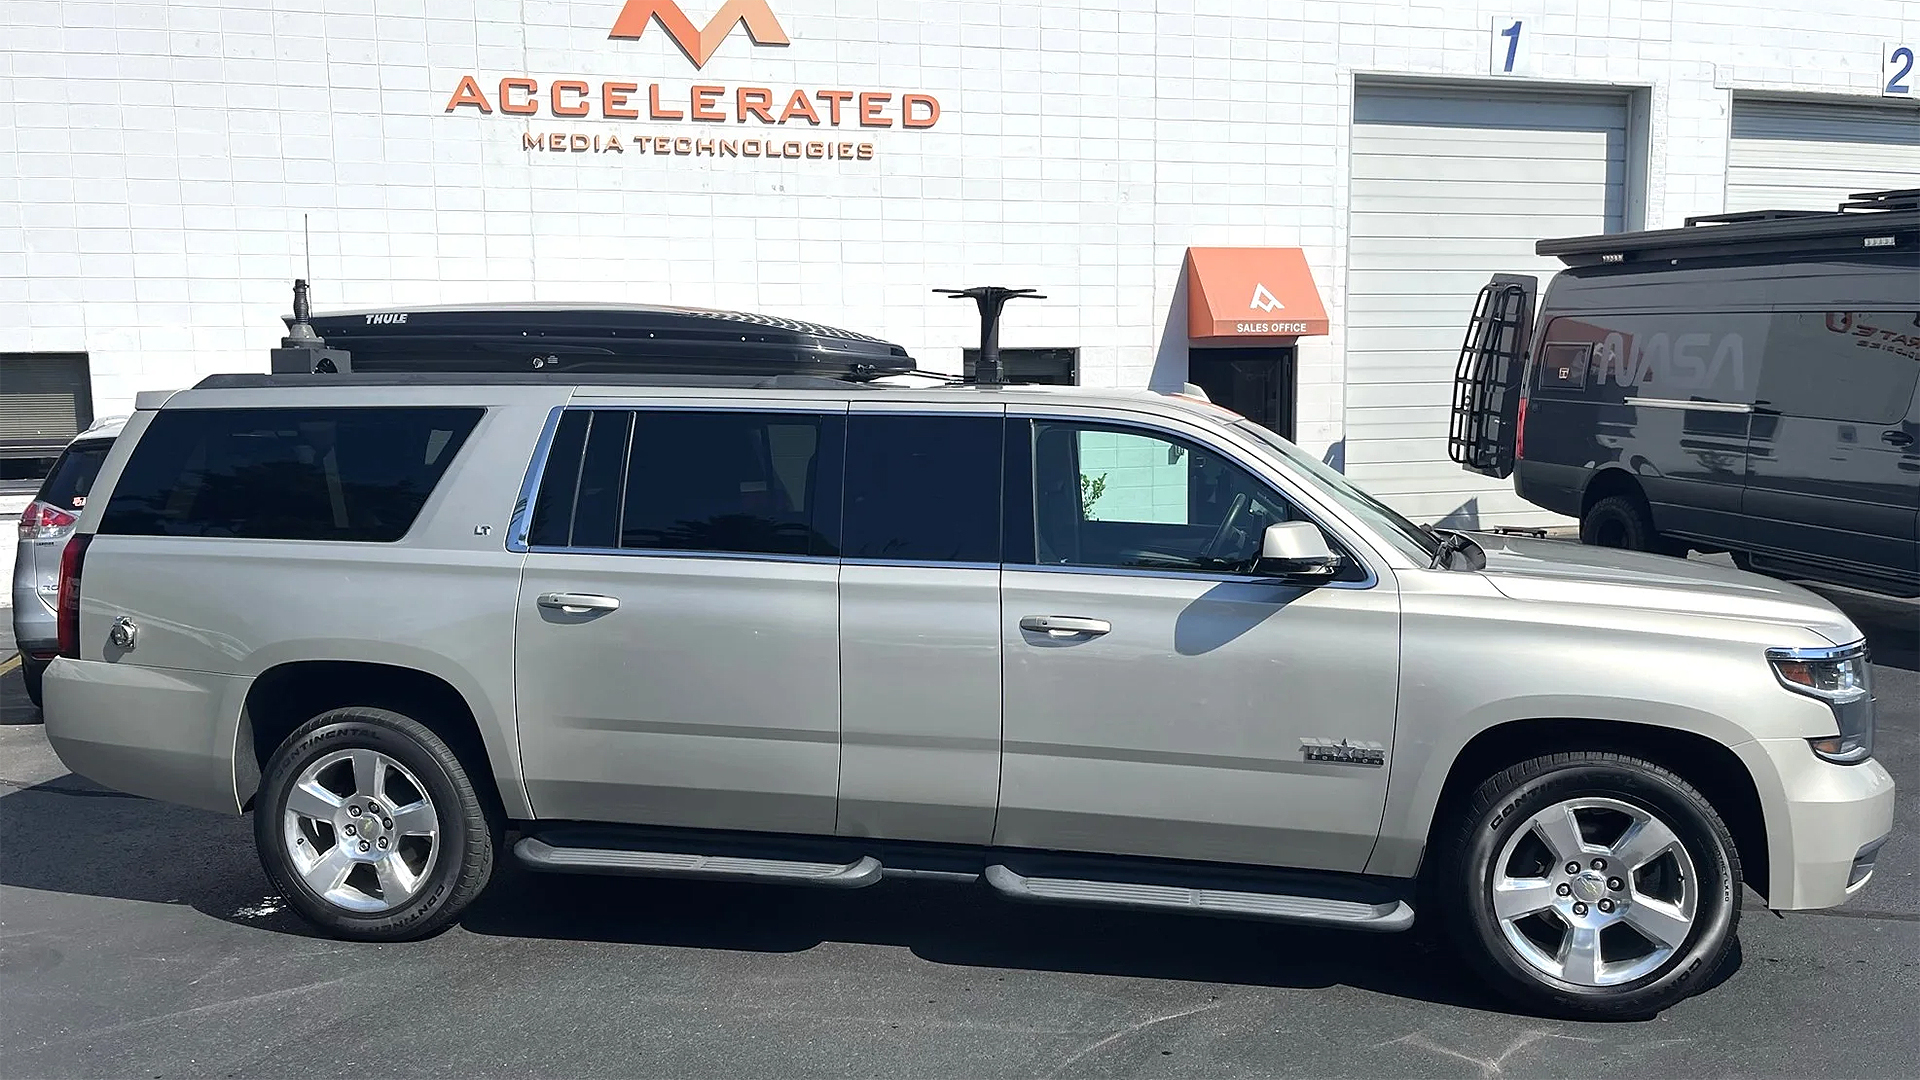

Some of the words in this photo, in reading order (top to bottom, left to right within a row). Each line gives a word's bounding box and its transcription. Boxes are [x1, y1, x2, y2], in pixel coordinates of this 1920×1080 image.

[1501, 20, 1523, 73] 1
[1885, 46, 1914, 94] 2
[445, 75, 941, 128] ACCELERATED
[522, 132, 624, 153] MEDIA
[633, 135, 874, 160] TECHNOLOGIES
[365, 313, 408, 325] THULE
[1237, 323, 1269, 333] SALES
[1271, 323, 1307, 333] OFFICE
[1597, 331, 1744, 391] NASA
[474, 525, 491, 536] LT
[275, 728, 382, 778] CONTINENTAL
[1310, 754, 1382, 765] EDITION
